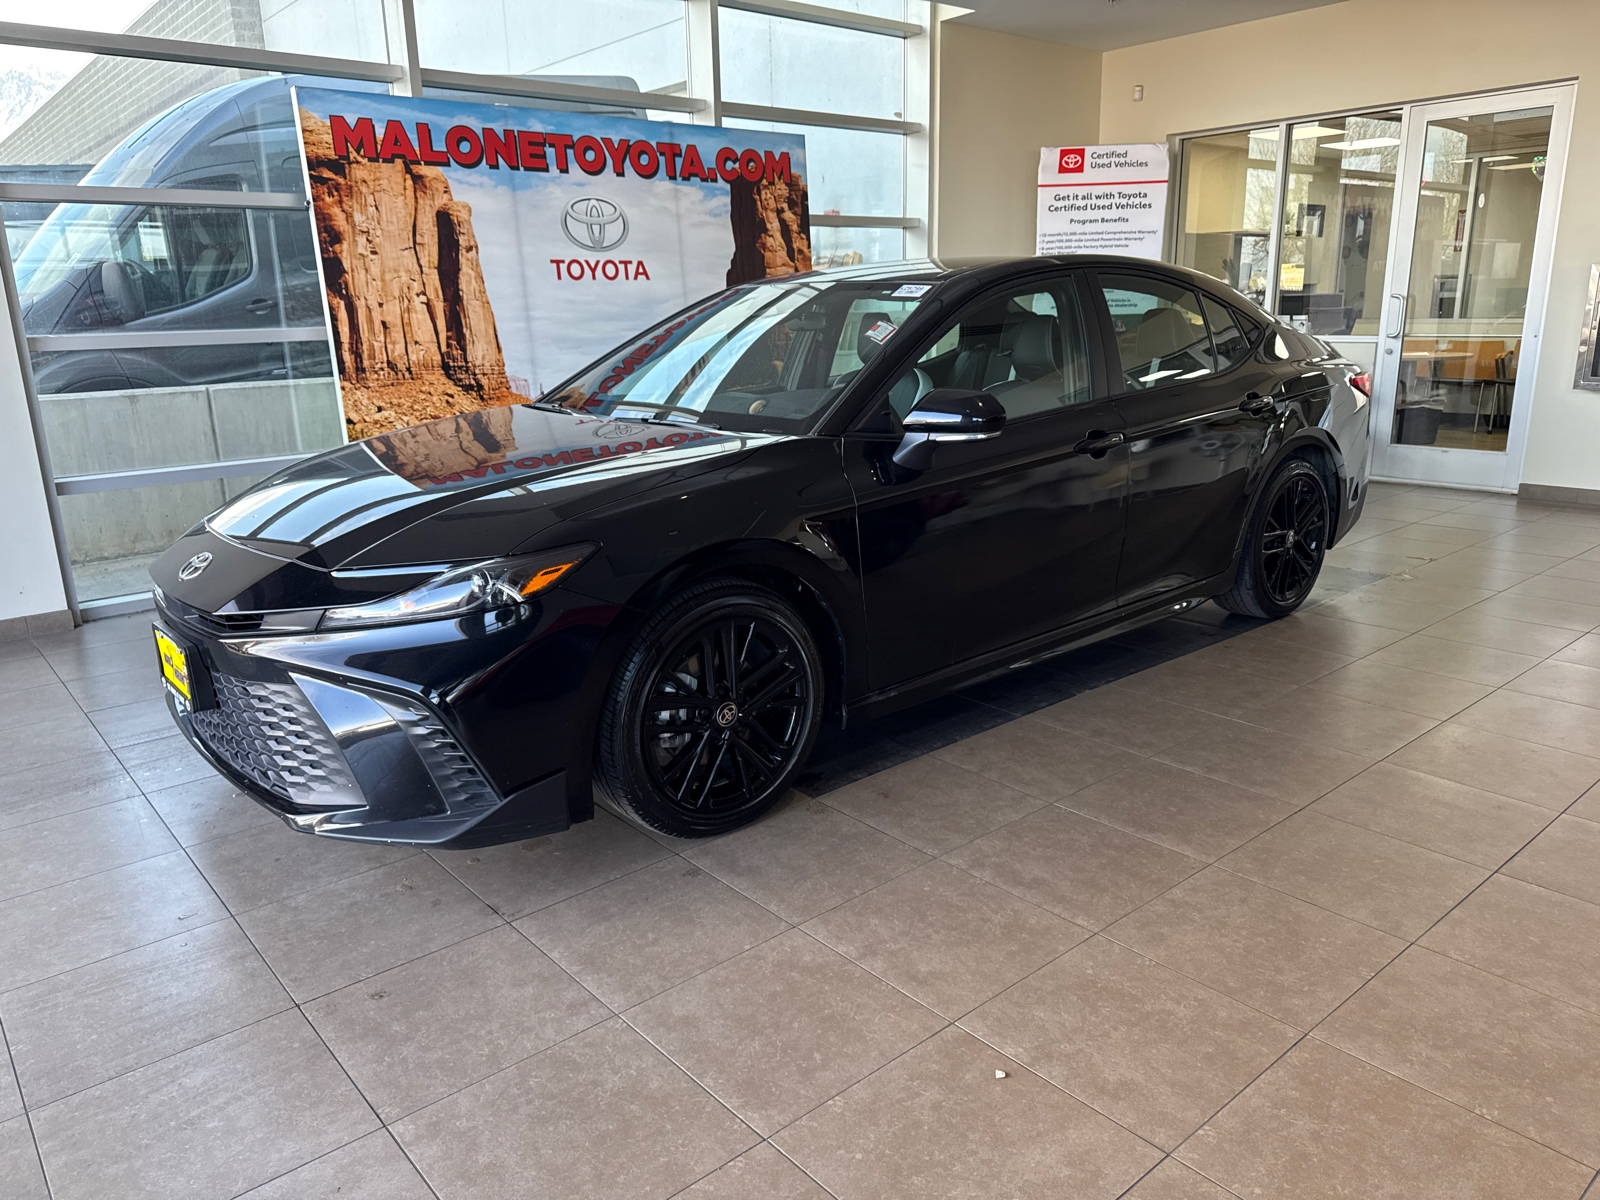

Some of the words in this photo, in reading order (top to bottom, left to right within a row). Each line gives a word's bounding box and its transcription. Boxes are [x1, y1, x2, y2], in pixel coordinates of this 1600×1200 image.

[328, 114, 792, 184] MALONETOYOTA.COM
[1090, 150, 1128, 160] Certified
[1090, 160, 1112, 169] Used
[1114, 160, 1149, 168] Vehicles
[1053, 194, 1071, 202] Get
[1072, 192, 1080, 201] it
[1080, 192, 1093, 200] all
[1094, 192, 1116, 200] with
[1116, 191, 1148, 200] Toyota
[1048, 203, 1088, 212] Certified
[1090, 202, 1113, 211] Used
[1114, 201, 1152, 210] Vehicles
[550, 259, 651, 281] TOYOTA
